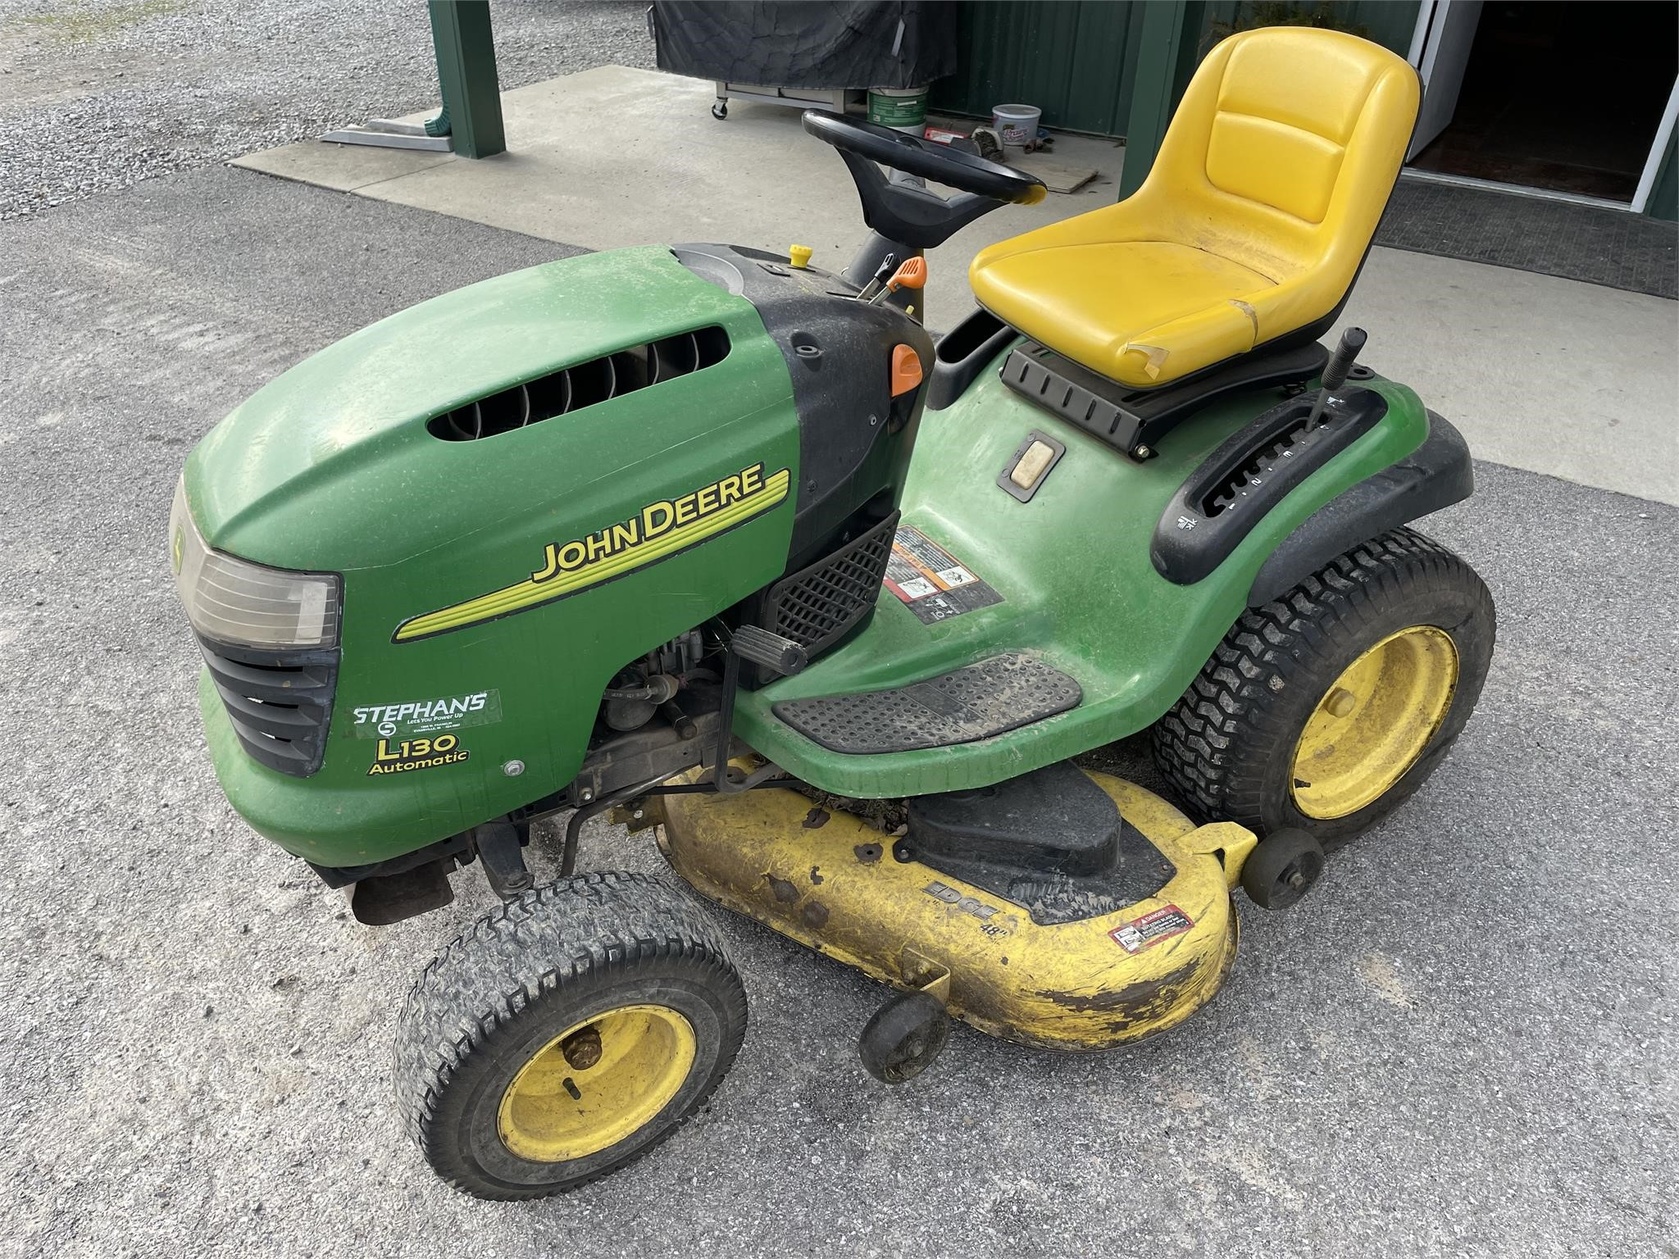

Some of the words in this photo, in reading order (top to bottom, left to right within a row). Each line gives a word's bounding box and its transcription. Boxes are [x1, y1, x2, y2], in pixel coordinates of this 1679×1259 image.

[1251, 477, 1262, 487] 2
[532, 518, 639, 582] JOHN
[642, 463, 763, 538] DEERE
[353, 692, 488, 724] STEPHAN'S
[376, 733, 458, 762] L130
[368, 750, 468, 775] Automatic
